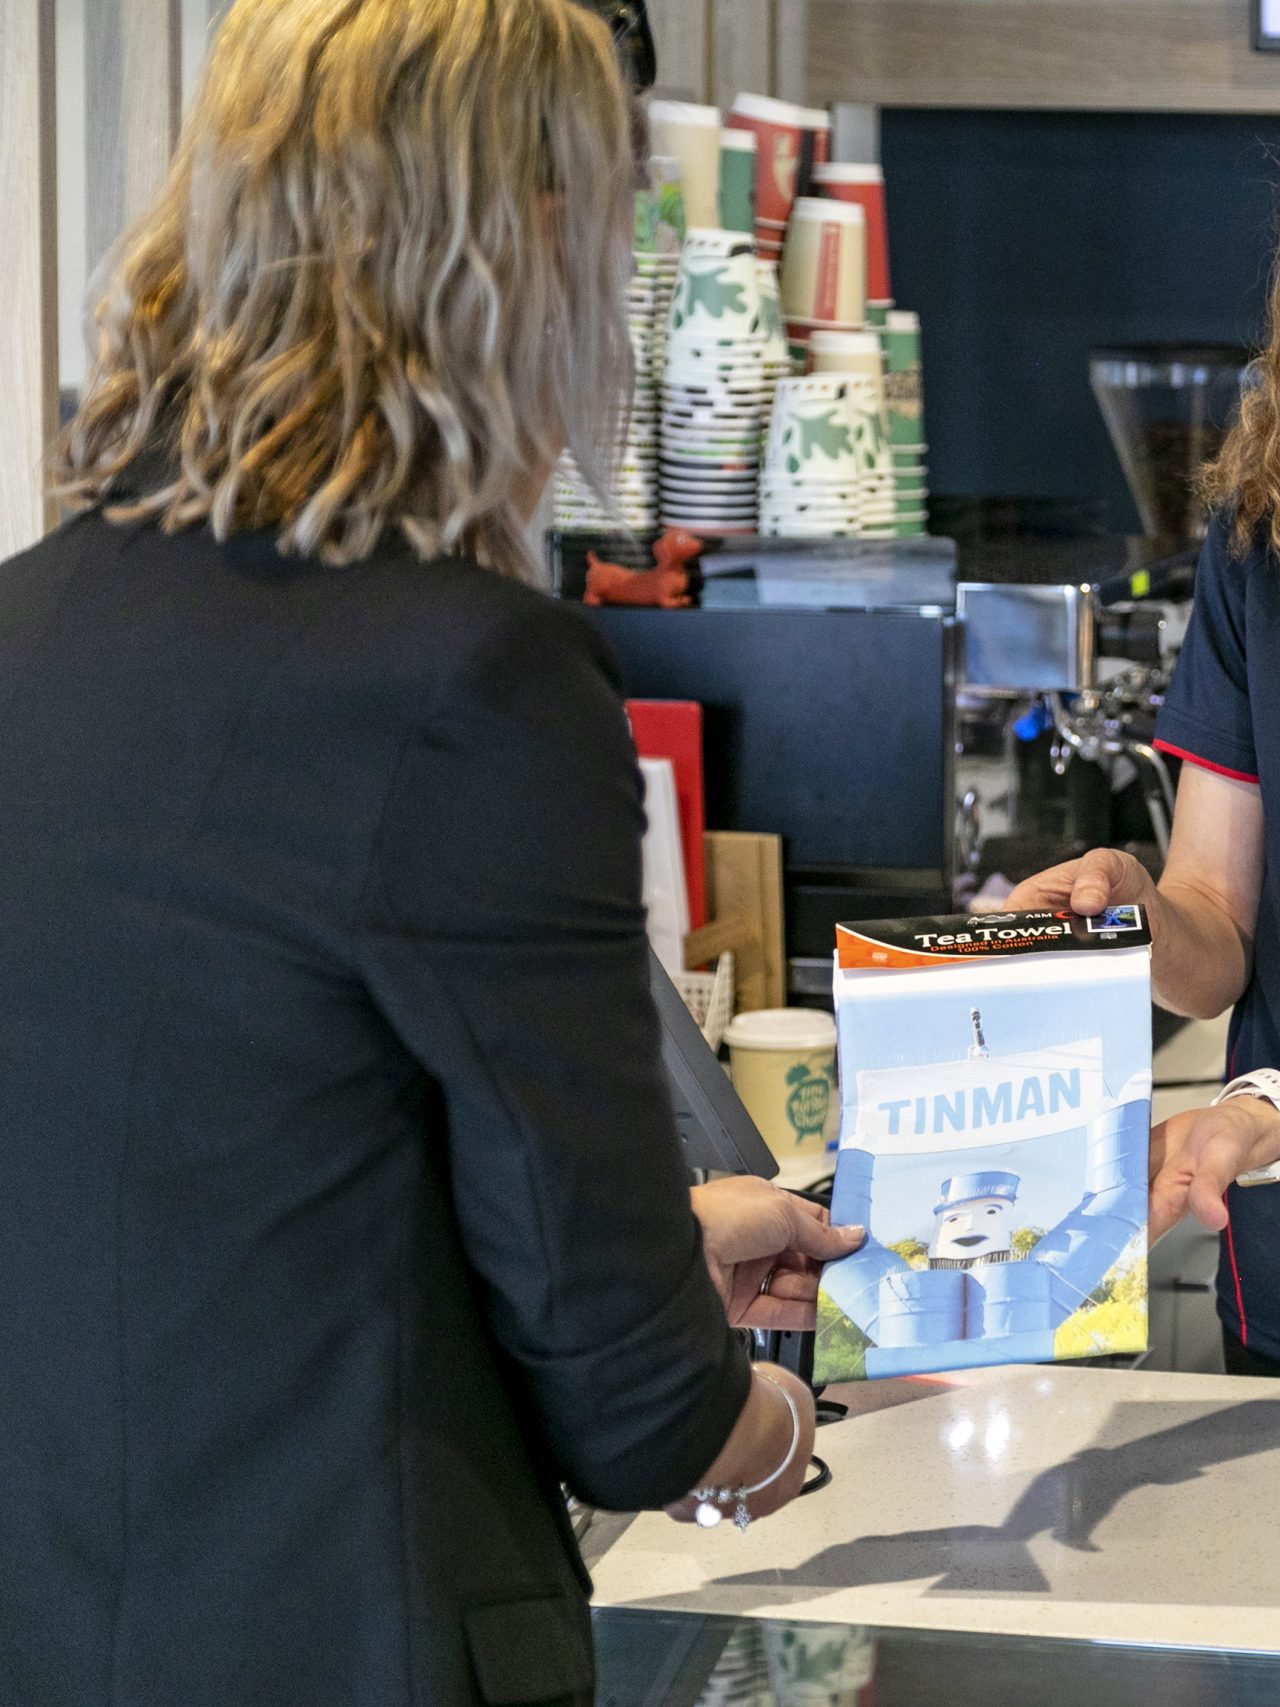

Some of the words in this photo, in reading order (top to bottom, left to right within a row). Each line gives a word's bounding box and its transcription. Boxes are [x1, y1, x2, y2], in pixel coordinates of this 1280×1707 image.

[1025, 911, 1052, 919] ASM
[914, 933, 972, 948] Tea
[975, 922, 1073, 941] Towel
[930, 940, 988, 952] Designed
[1001, 934, 1059, 943] Australia
[992, 941, 1034, 949] Cotton
[878, 1068, 1081, 1135] TINMAN
